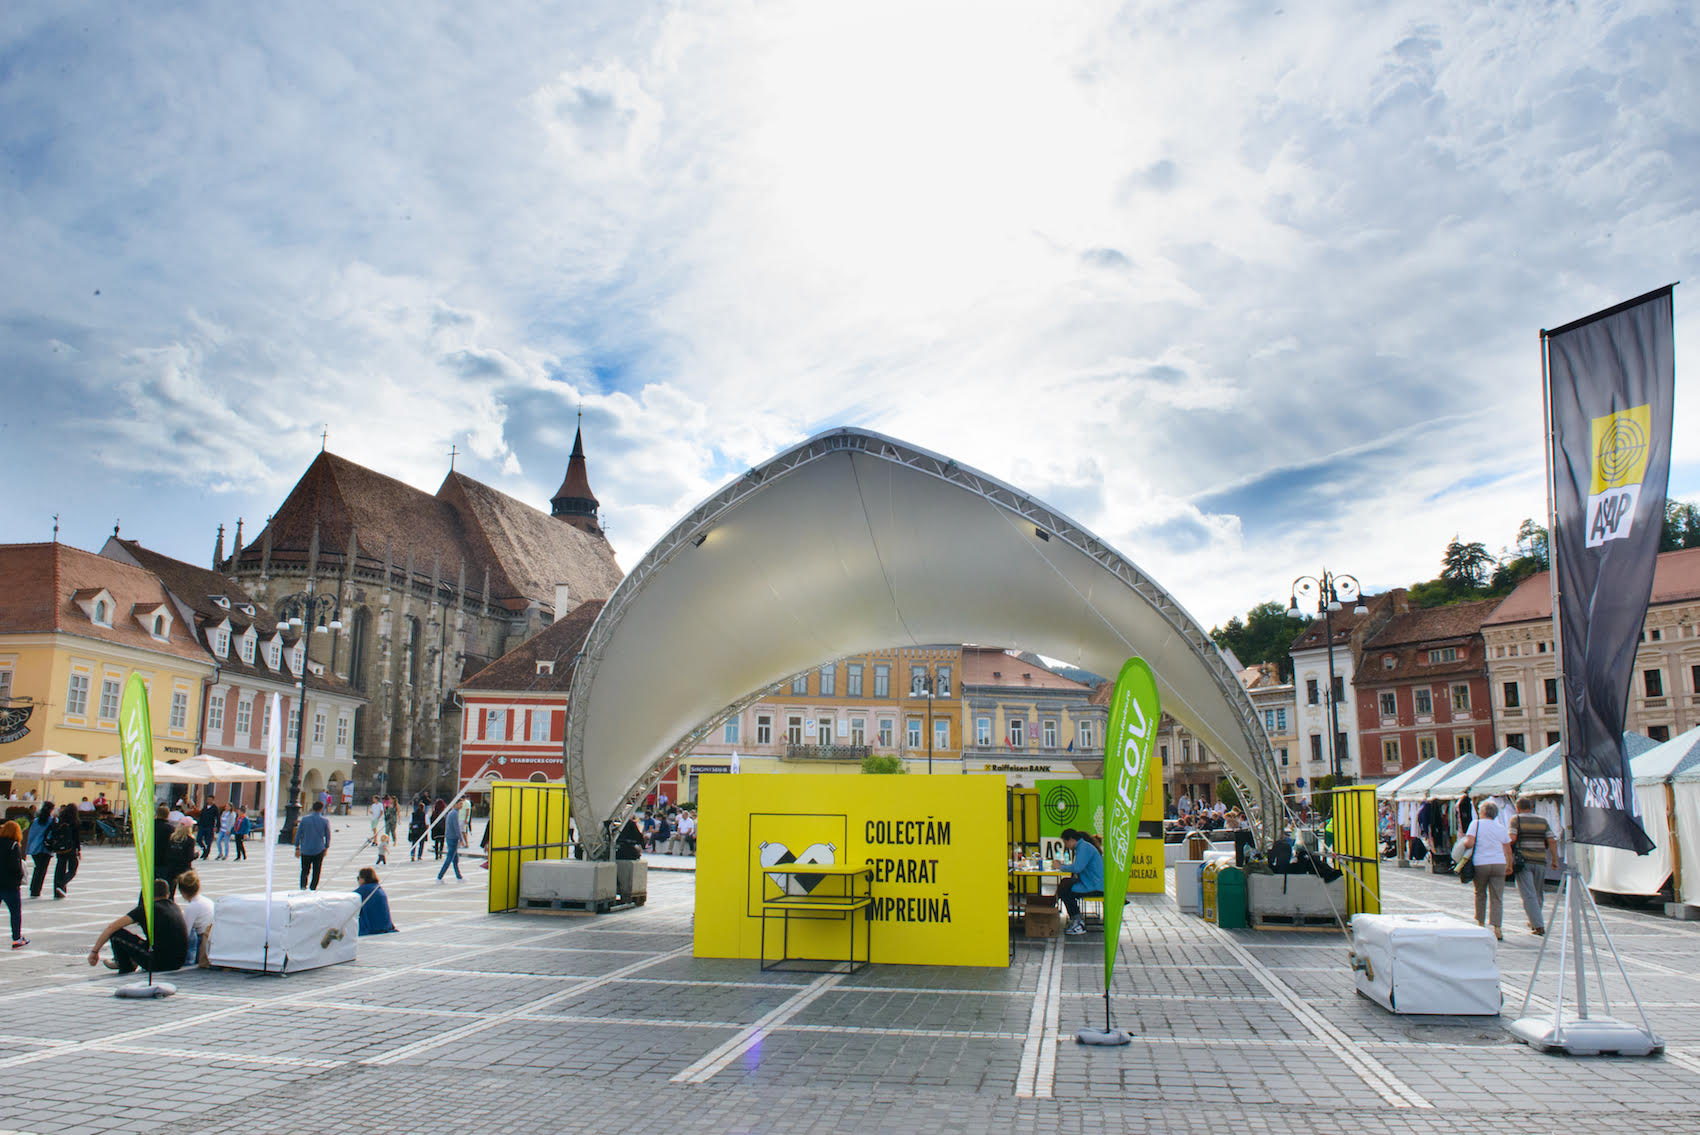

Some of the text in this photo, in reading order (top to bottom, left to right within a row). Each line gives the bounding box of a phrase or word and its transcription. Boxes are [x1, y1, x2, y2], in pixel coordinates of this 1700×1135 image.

[1118, 697, 1147, 809] FOV
[991, 764, 1052, 773] Raiffeisen BANK
[865, 816, 951, 846] COLECTĂM
[865, 858, 939, 884] SEPARAT
